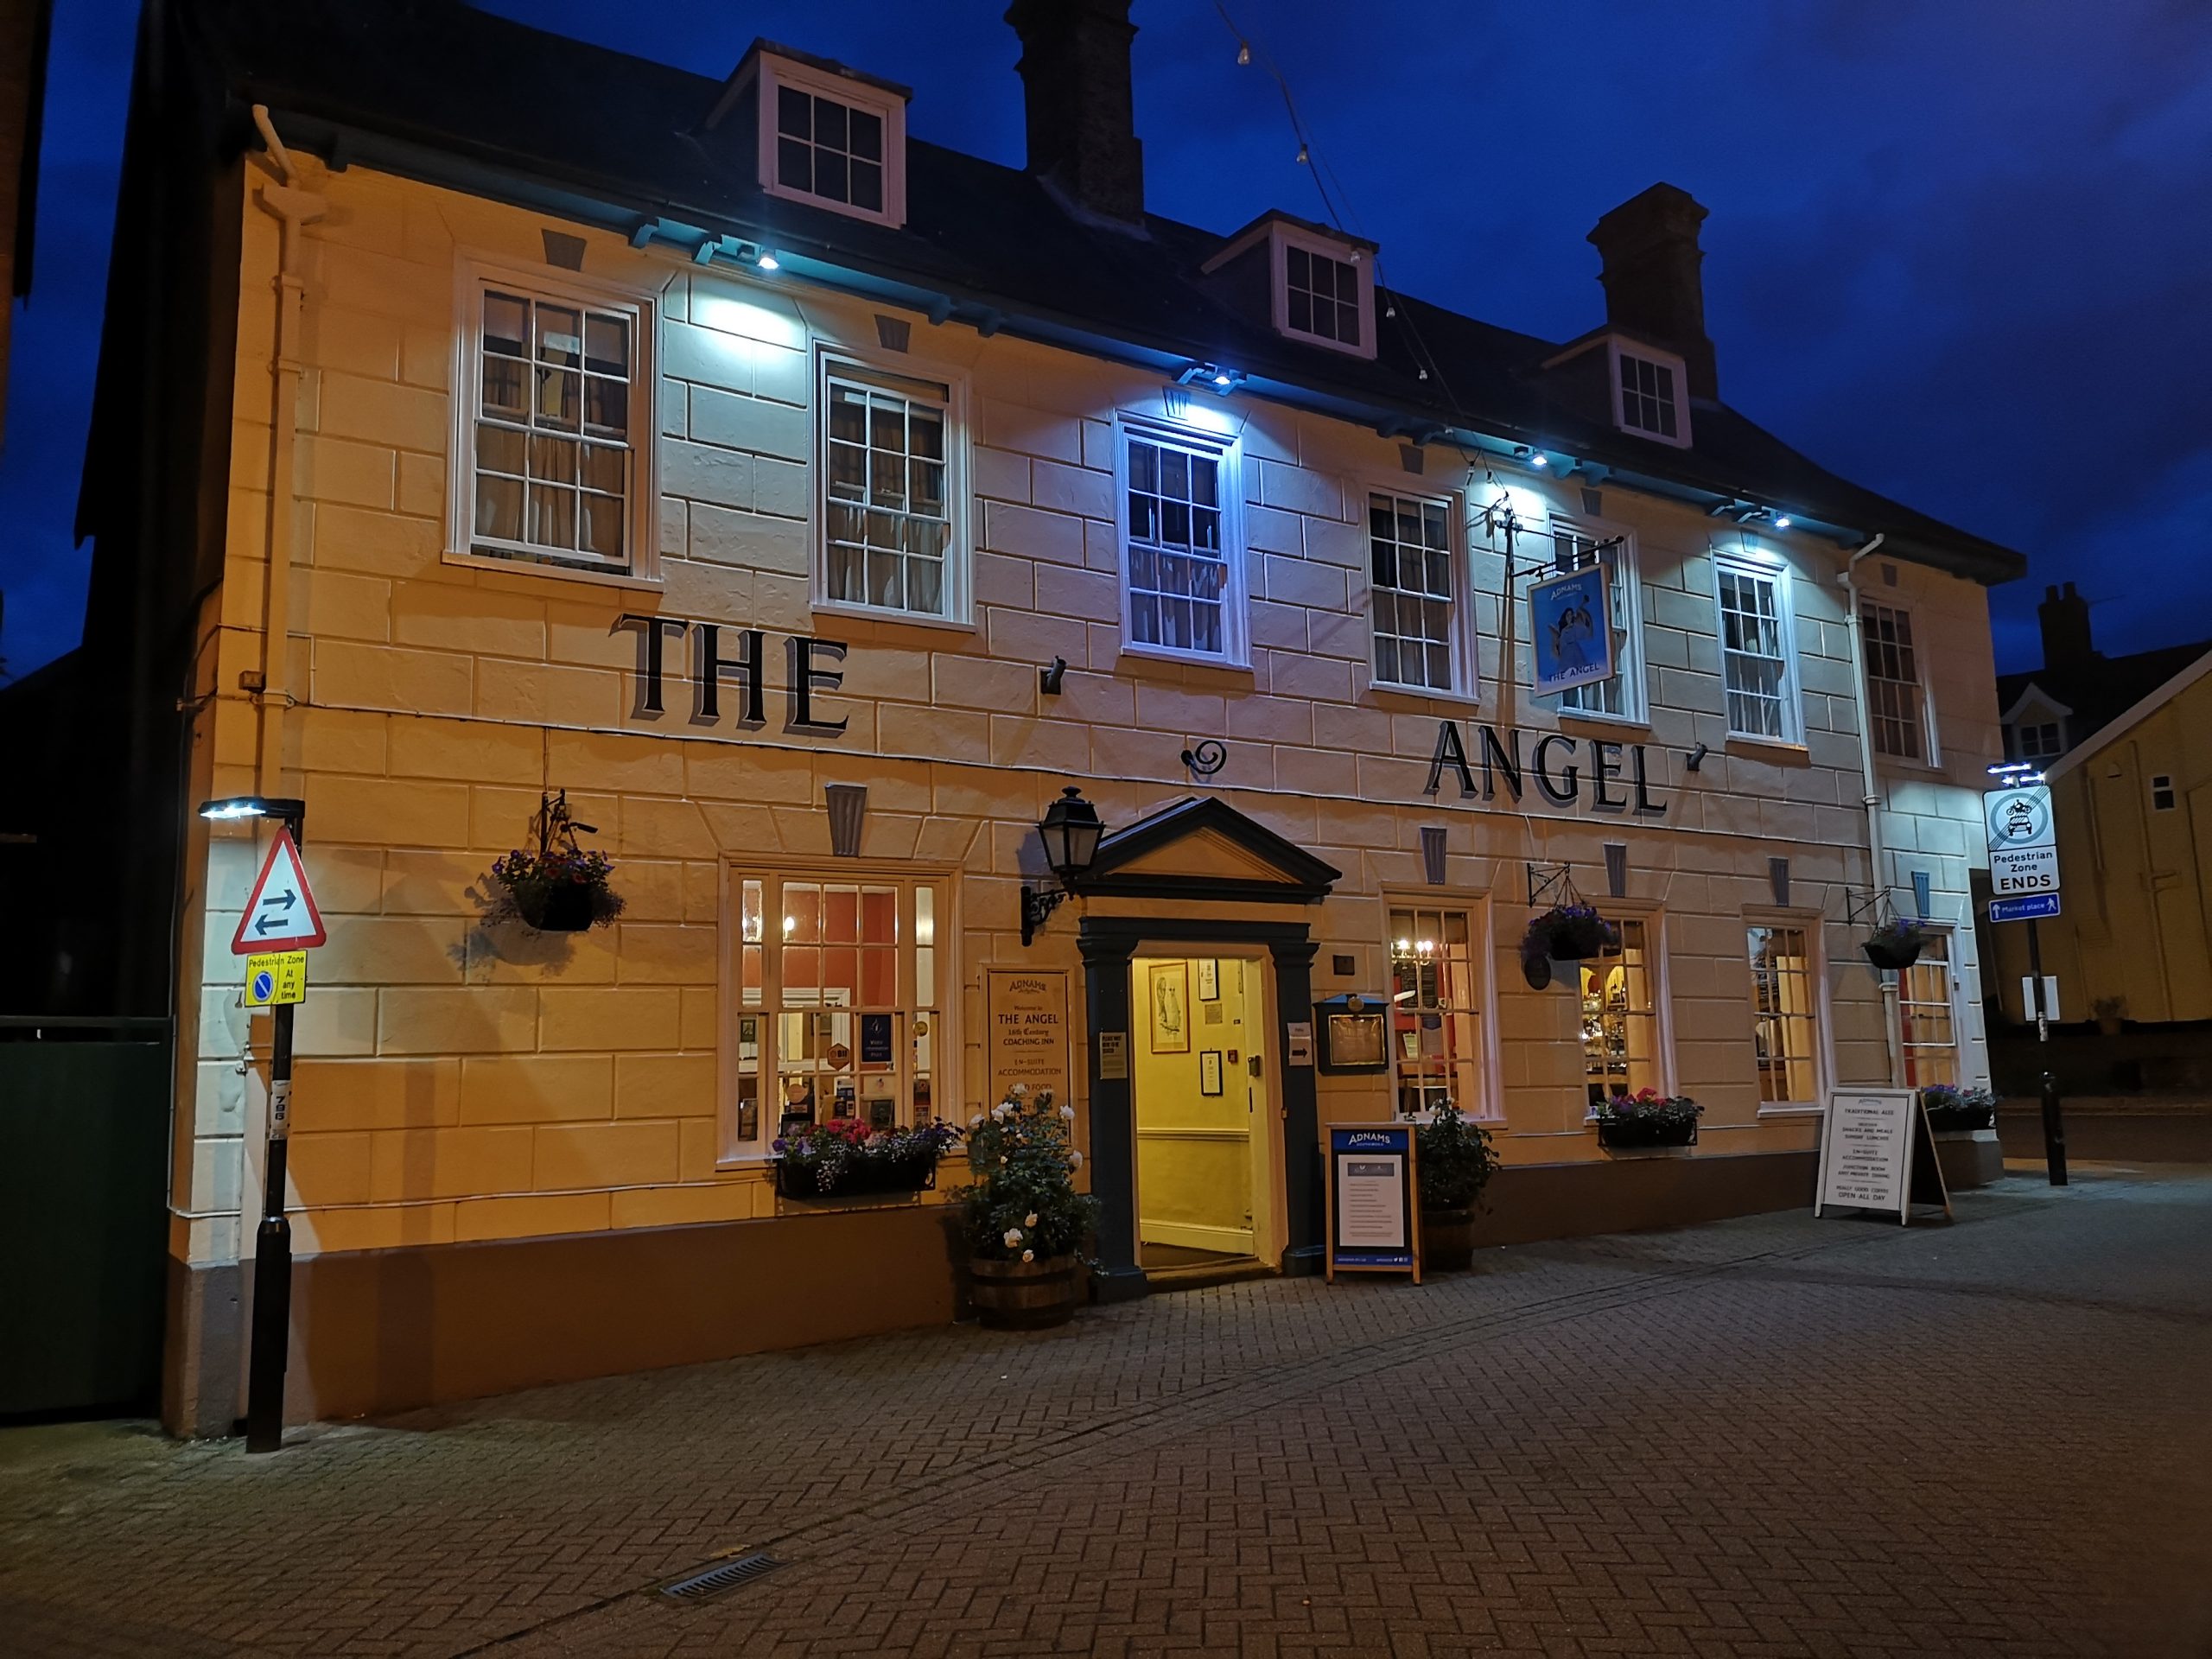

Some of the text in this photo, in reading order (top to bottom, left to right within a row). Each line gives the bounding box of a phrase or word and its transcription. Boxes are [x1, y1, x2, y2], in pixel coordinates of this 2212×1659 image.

[1550, 583, 1583, 601] ADNAMS
[608, 613, 849, 739] THE
[1548, 663, 1600, 683] THE ANGEL
[1422, 720, 1669, 817] ANGEL
[1993, 851, 2053, 864] Pedestrian
[2011, 864, 2037, 873] Zone
[2000, 874, 2051, 890] ENDS
[2001, 904, 2025, 912] Market
[249, 955, 305, 968] Pedestrian Zone
[286, 969, 294, 978] At
[283, 981, 296, 990] any
[1009, 979, 1046, 992] ADNAMS
[281, 991, 296, 1000] time
[998, 1014, 1058, 1025] THE ANGEL
[998, 1067, 1062, 1077] ACCOMMODATION
[1348, 1132, 1390, 1146] ADNAMS
